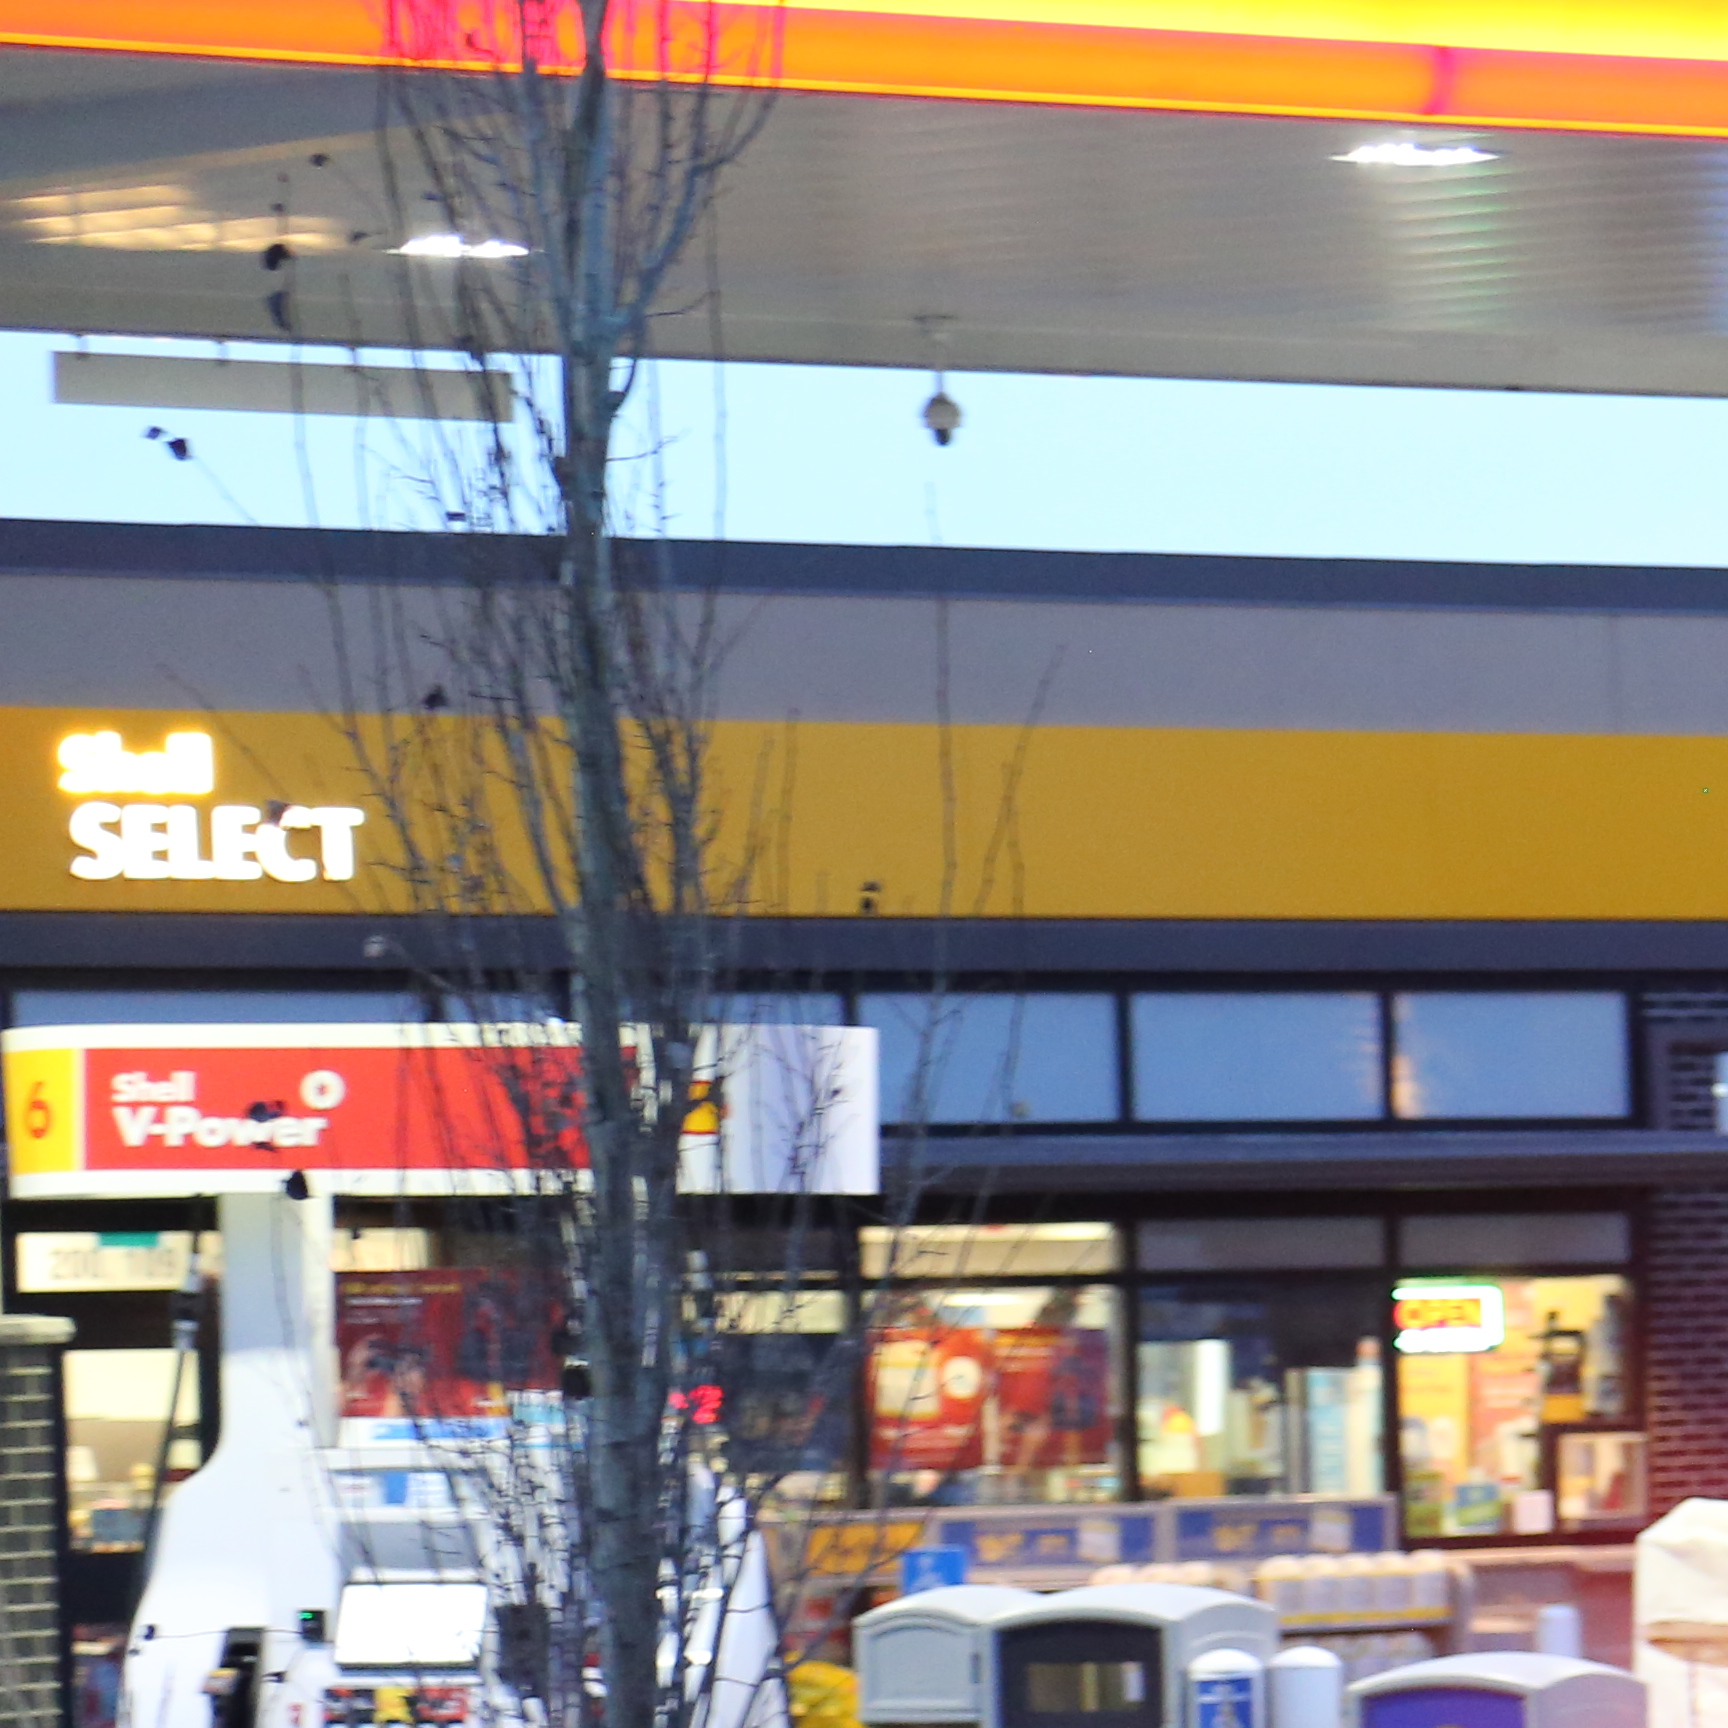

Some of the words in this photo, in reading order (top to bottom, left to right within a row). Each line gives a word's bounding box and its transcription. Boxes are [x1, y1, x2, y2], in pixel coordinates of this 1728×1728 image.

[68, 801, 366, 882] SELECT
[24, 1080, 55, 1139] 6
[110, 1070, 198, 1103] Shell
[111, 1105, 330, 1147] V-Power
